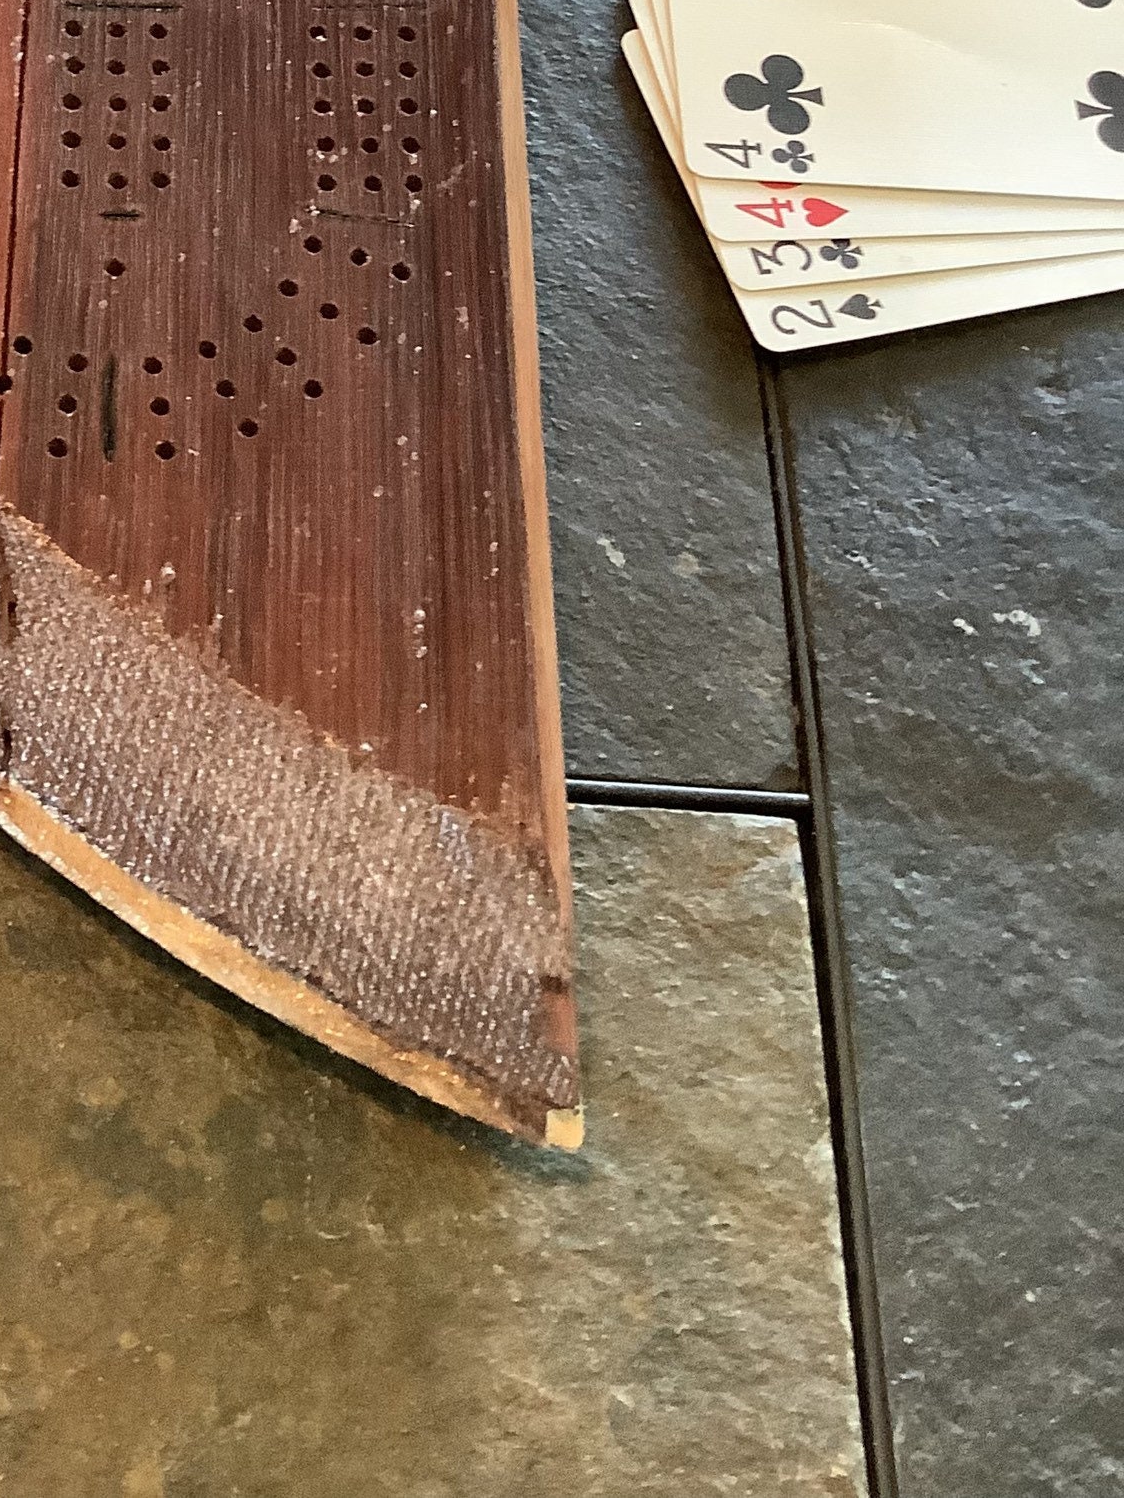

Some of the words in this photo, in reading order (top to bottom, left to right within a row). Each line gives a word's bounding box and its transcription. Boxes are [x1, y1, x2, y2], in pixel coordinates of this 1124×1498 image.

[704, 139, 763, 169] 4
[734, 197, 795, 228] 4
[750, 240, 812, 275] 3
[771, 299, 835, 335] 2
